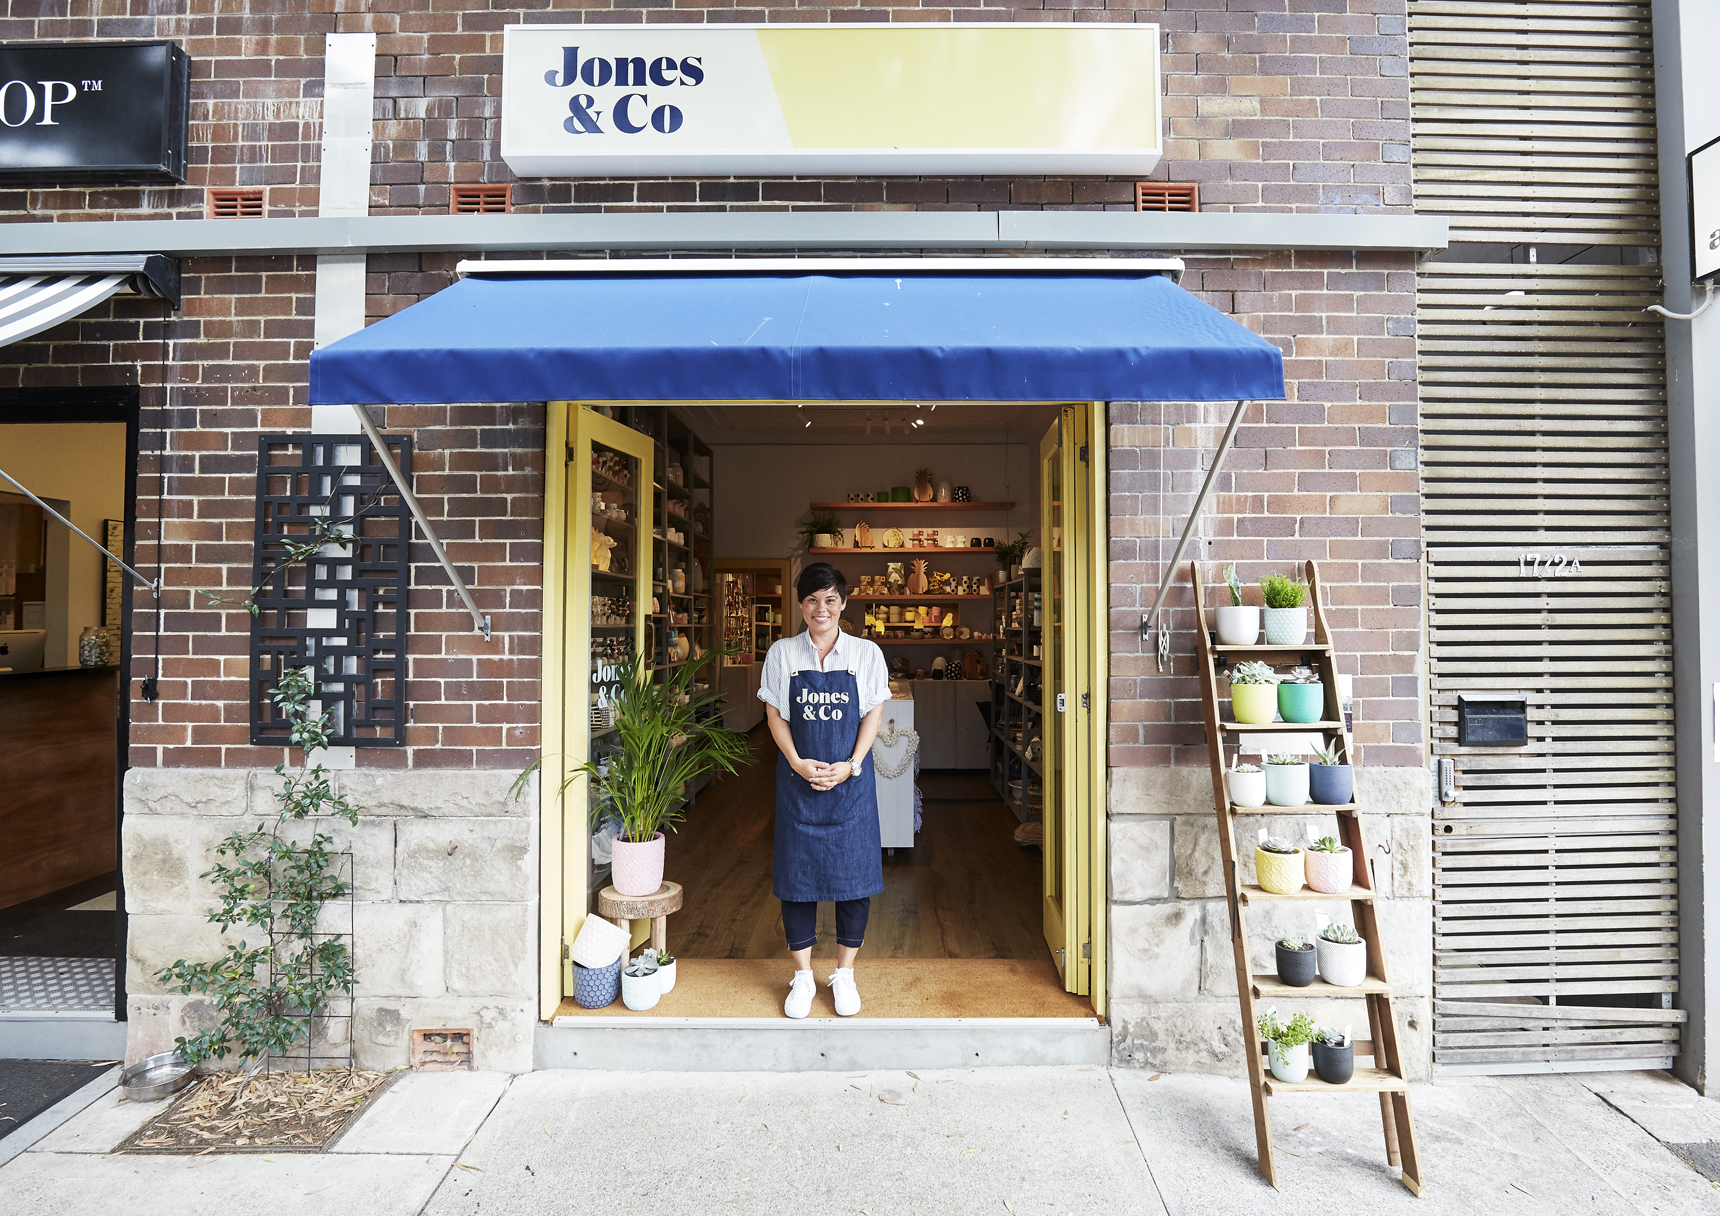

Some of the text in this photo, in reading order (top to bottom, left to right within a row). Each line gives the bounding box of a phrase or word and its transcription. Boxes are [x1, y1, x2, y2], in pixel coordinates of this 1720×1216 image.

[544, 46, 704, 87] Jones
[563, 93, 683, 134] & Co
[1518, 552, 1582, 578] 17/2A
[597, 685, 609, 708] &
[796, 688, 850, 704] Jones
[802, 705, 843, 721] & Co
